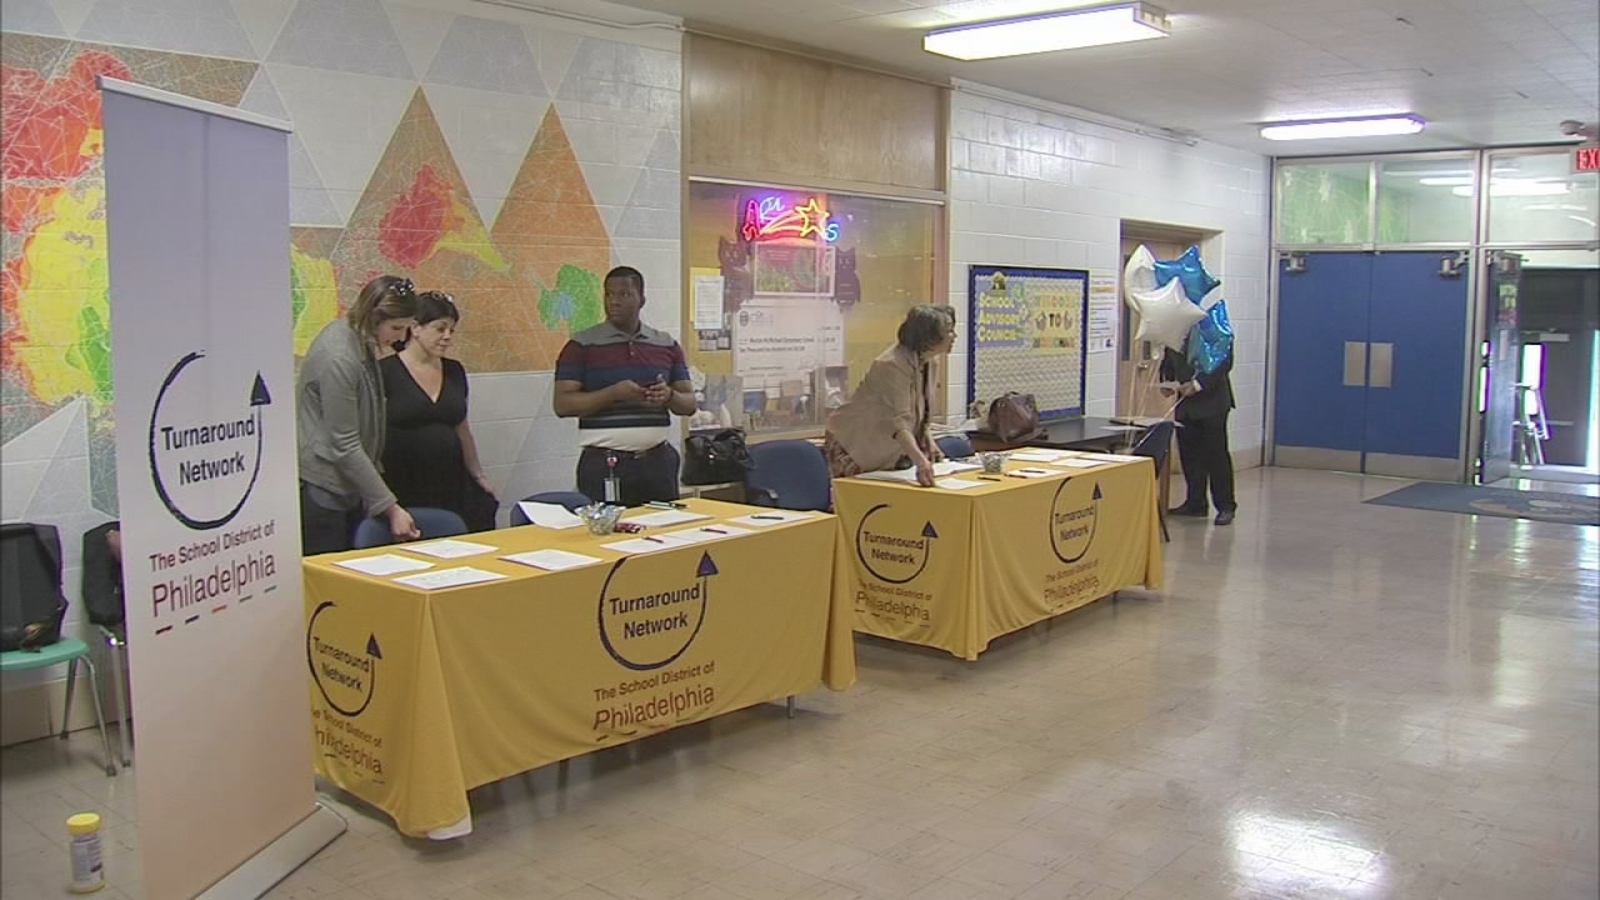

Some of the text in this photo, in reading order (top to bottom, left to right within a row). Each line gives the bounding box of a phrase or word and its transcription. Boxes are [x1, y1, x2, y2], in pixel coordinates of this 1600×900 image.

[1579, 149, 1600, 170] EX
[161, 414, 255, 450] Turnaround
[180, 451, 246, 486] Network
[150, 519, 276, 573] The School District of
[863, 530, 924, 550] Turnaround
[871, 548, 915, 565] Network
[152, 551, 276, 618] Philadelphia
[610, 583, 700, 616] Turnaround
[624, 611, 689, 640] Network
[313, 636, 370, 673] Turnaround
[321, 662, 363, 692] Network
[593, 660, 716, 702] The School District of
[592, 685, 715, 731] Philadelphia
[314, 724, 382, 774] hiladelphia
